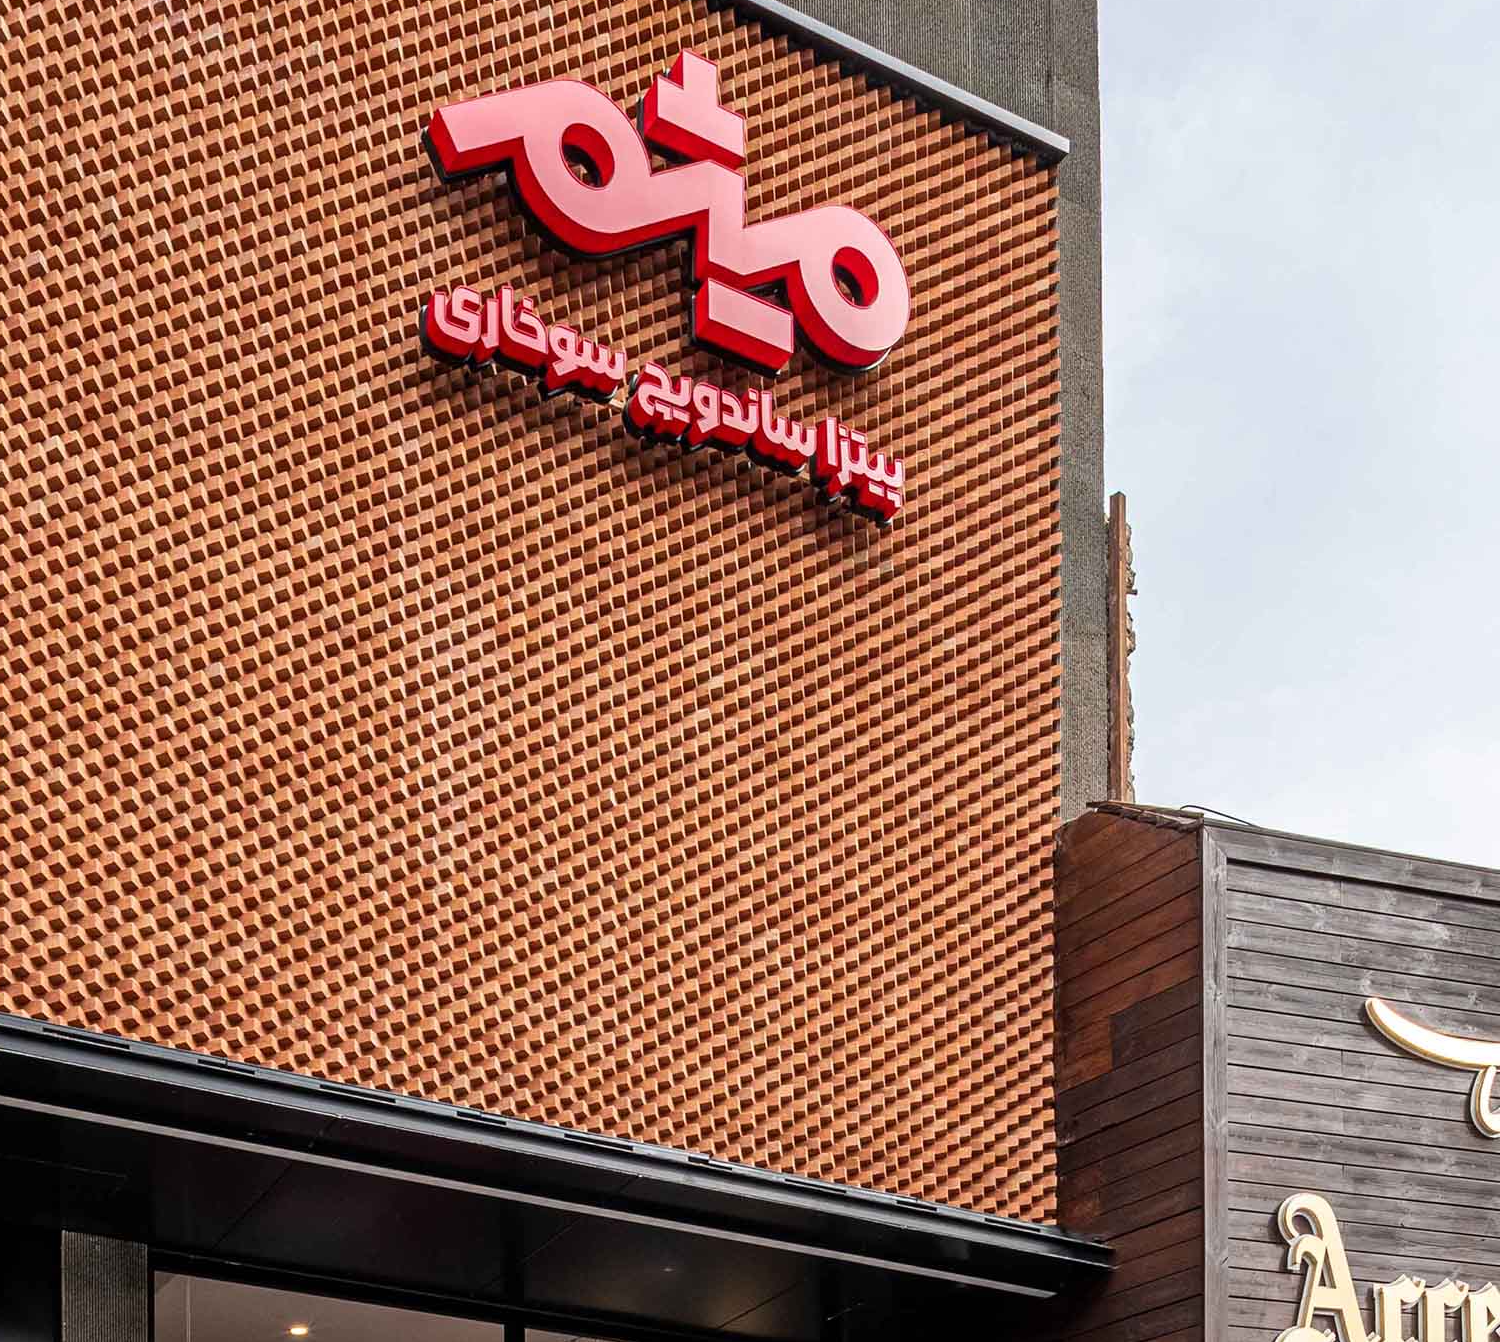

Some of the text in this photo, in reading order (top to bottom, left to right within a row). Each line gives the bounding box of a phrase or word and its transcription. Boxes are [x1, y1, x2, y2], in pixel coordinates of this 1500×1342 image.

[426, 48, 911, 372] میثم
[424, 285, 904, 521] پیتزا ساندویچ سوخاری
